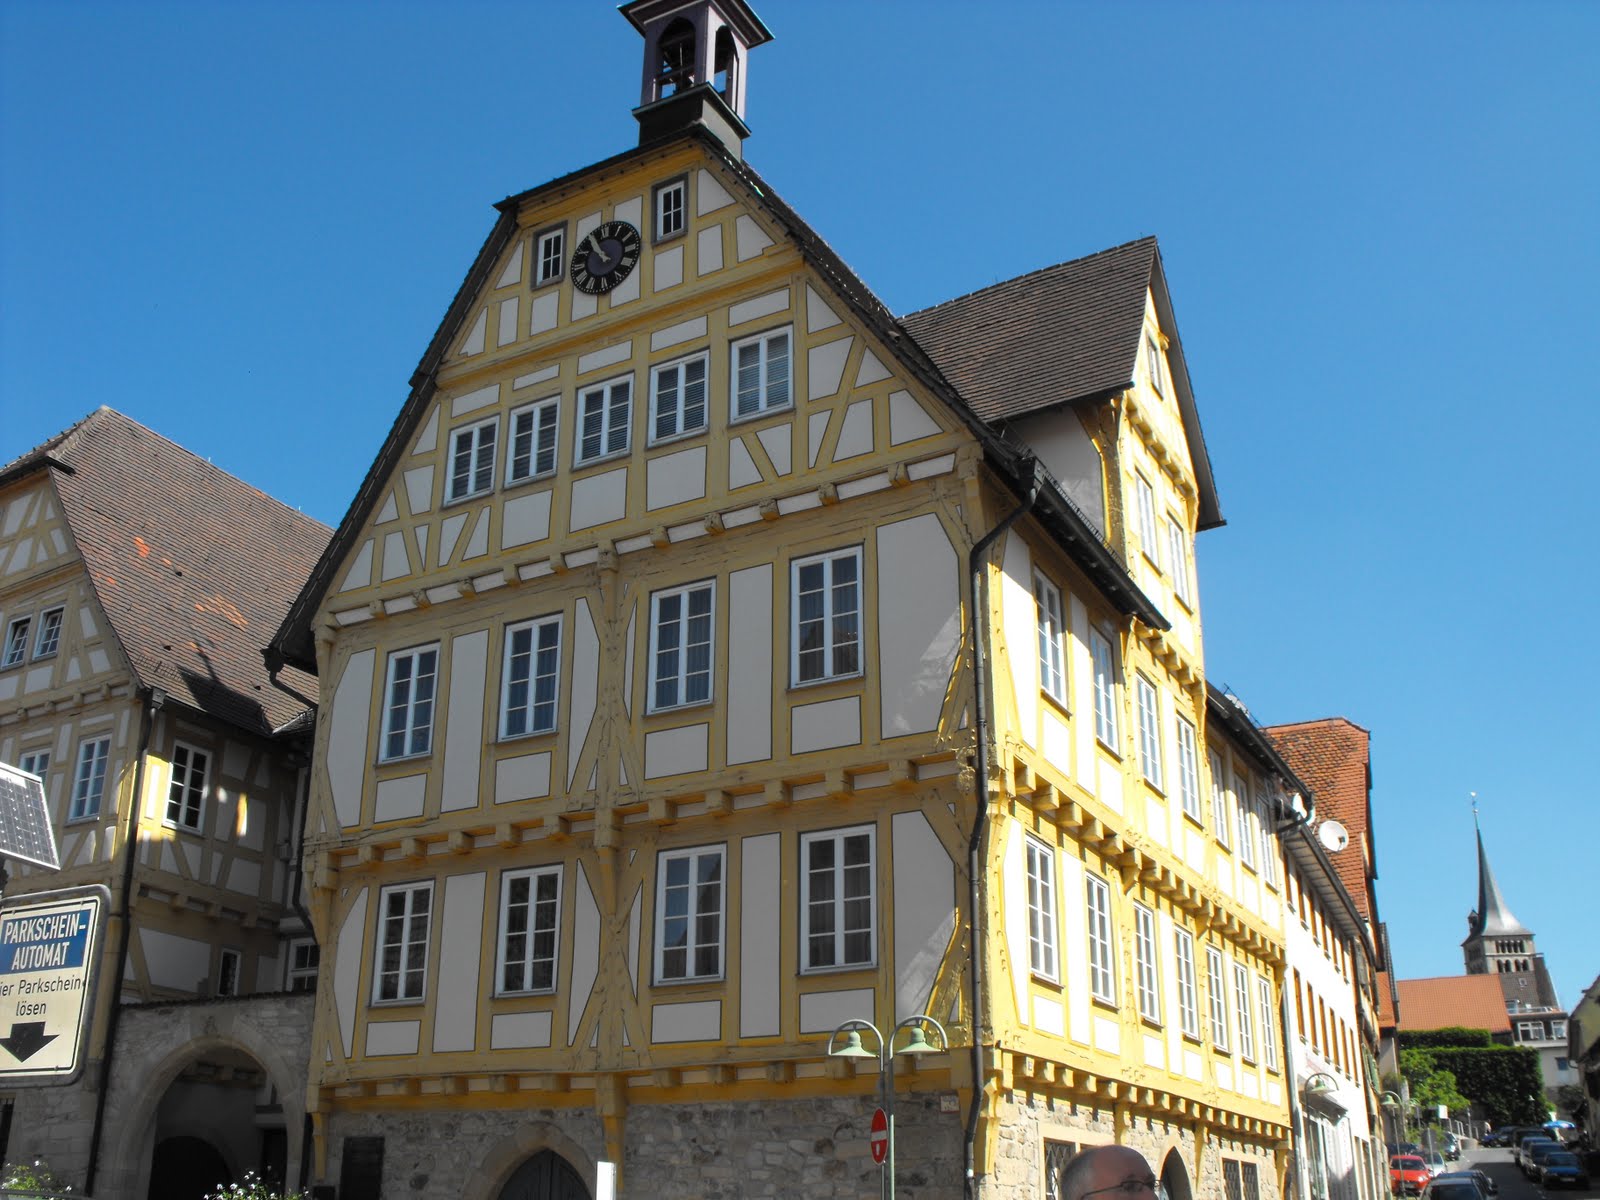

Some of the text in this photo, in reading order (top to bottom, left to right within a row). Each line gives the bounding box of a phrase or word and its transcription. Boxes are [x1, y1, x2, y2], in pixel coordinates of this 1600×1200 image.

[4, 913, 86, 944] PARKSCHEIN-
[11, 942, 70, 971] AUTOMAT
[18, 975, 81, 995] Parkschein
[16, 1001, 47, 1016] lösen
